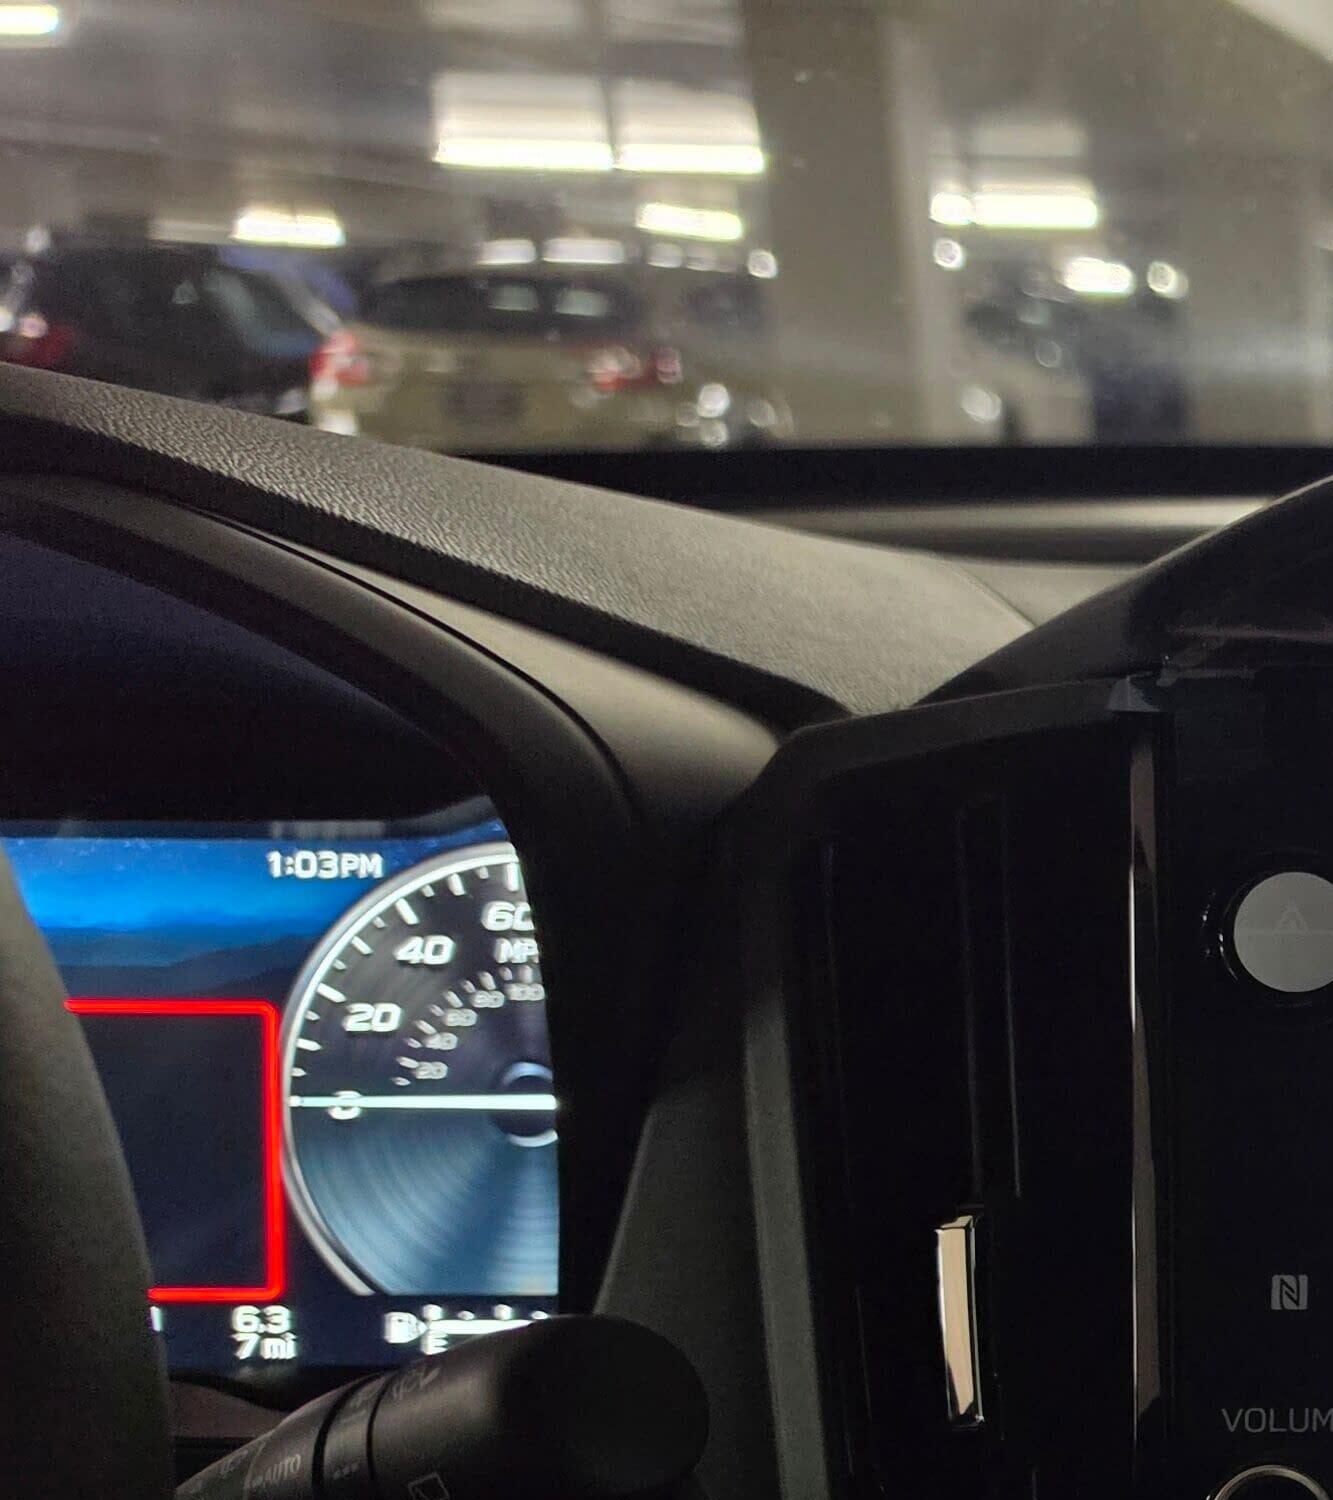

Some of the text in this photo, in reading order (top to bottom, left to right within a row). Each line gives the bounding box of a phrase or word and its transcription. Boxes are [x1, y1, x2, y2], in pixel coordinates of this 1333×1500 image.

[266, 850, 385, 879] 1:03PM
[393, 934, 456, 965] 40
[494, 937, 541, 964] MP
[343, 1003, 402, 1032] 20
[232, 1304, 292, 1334] 6.3
